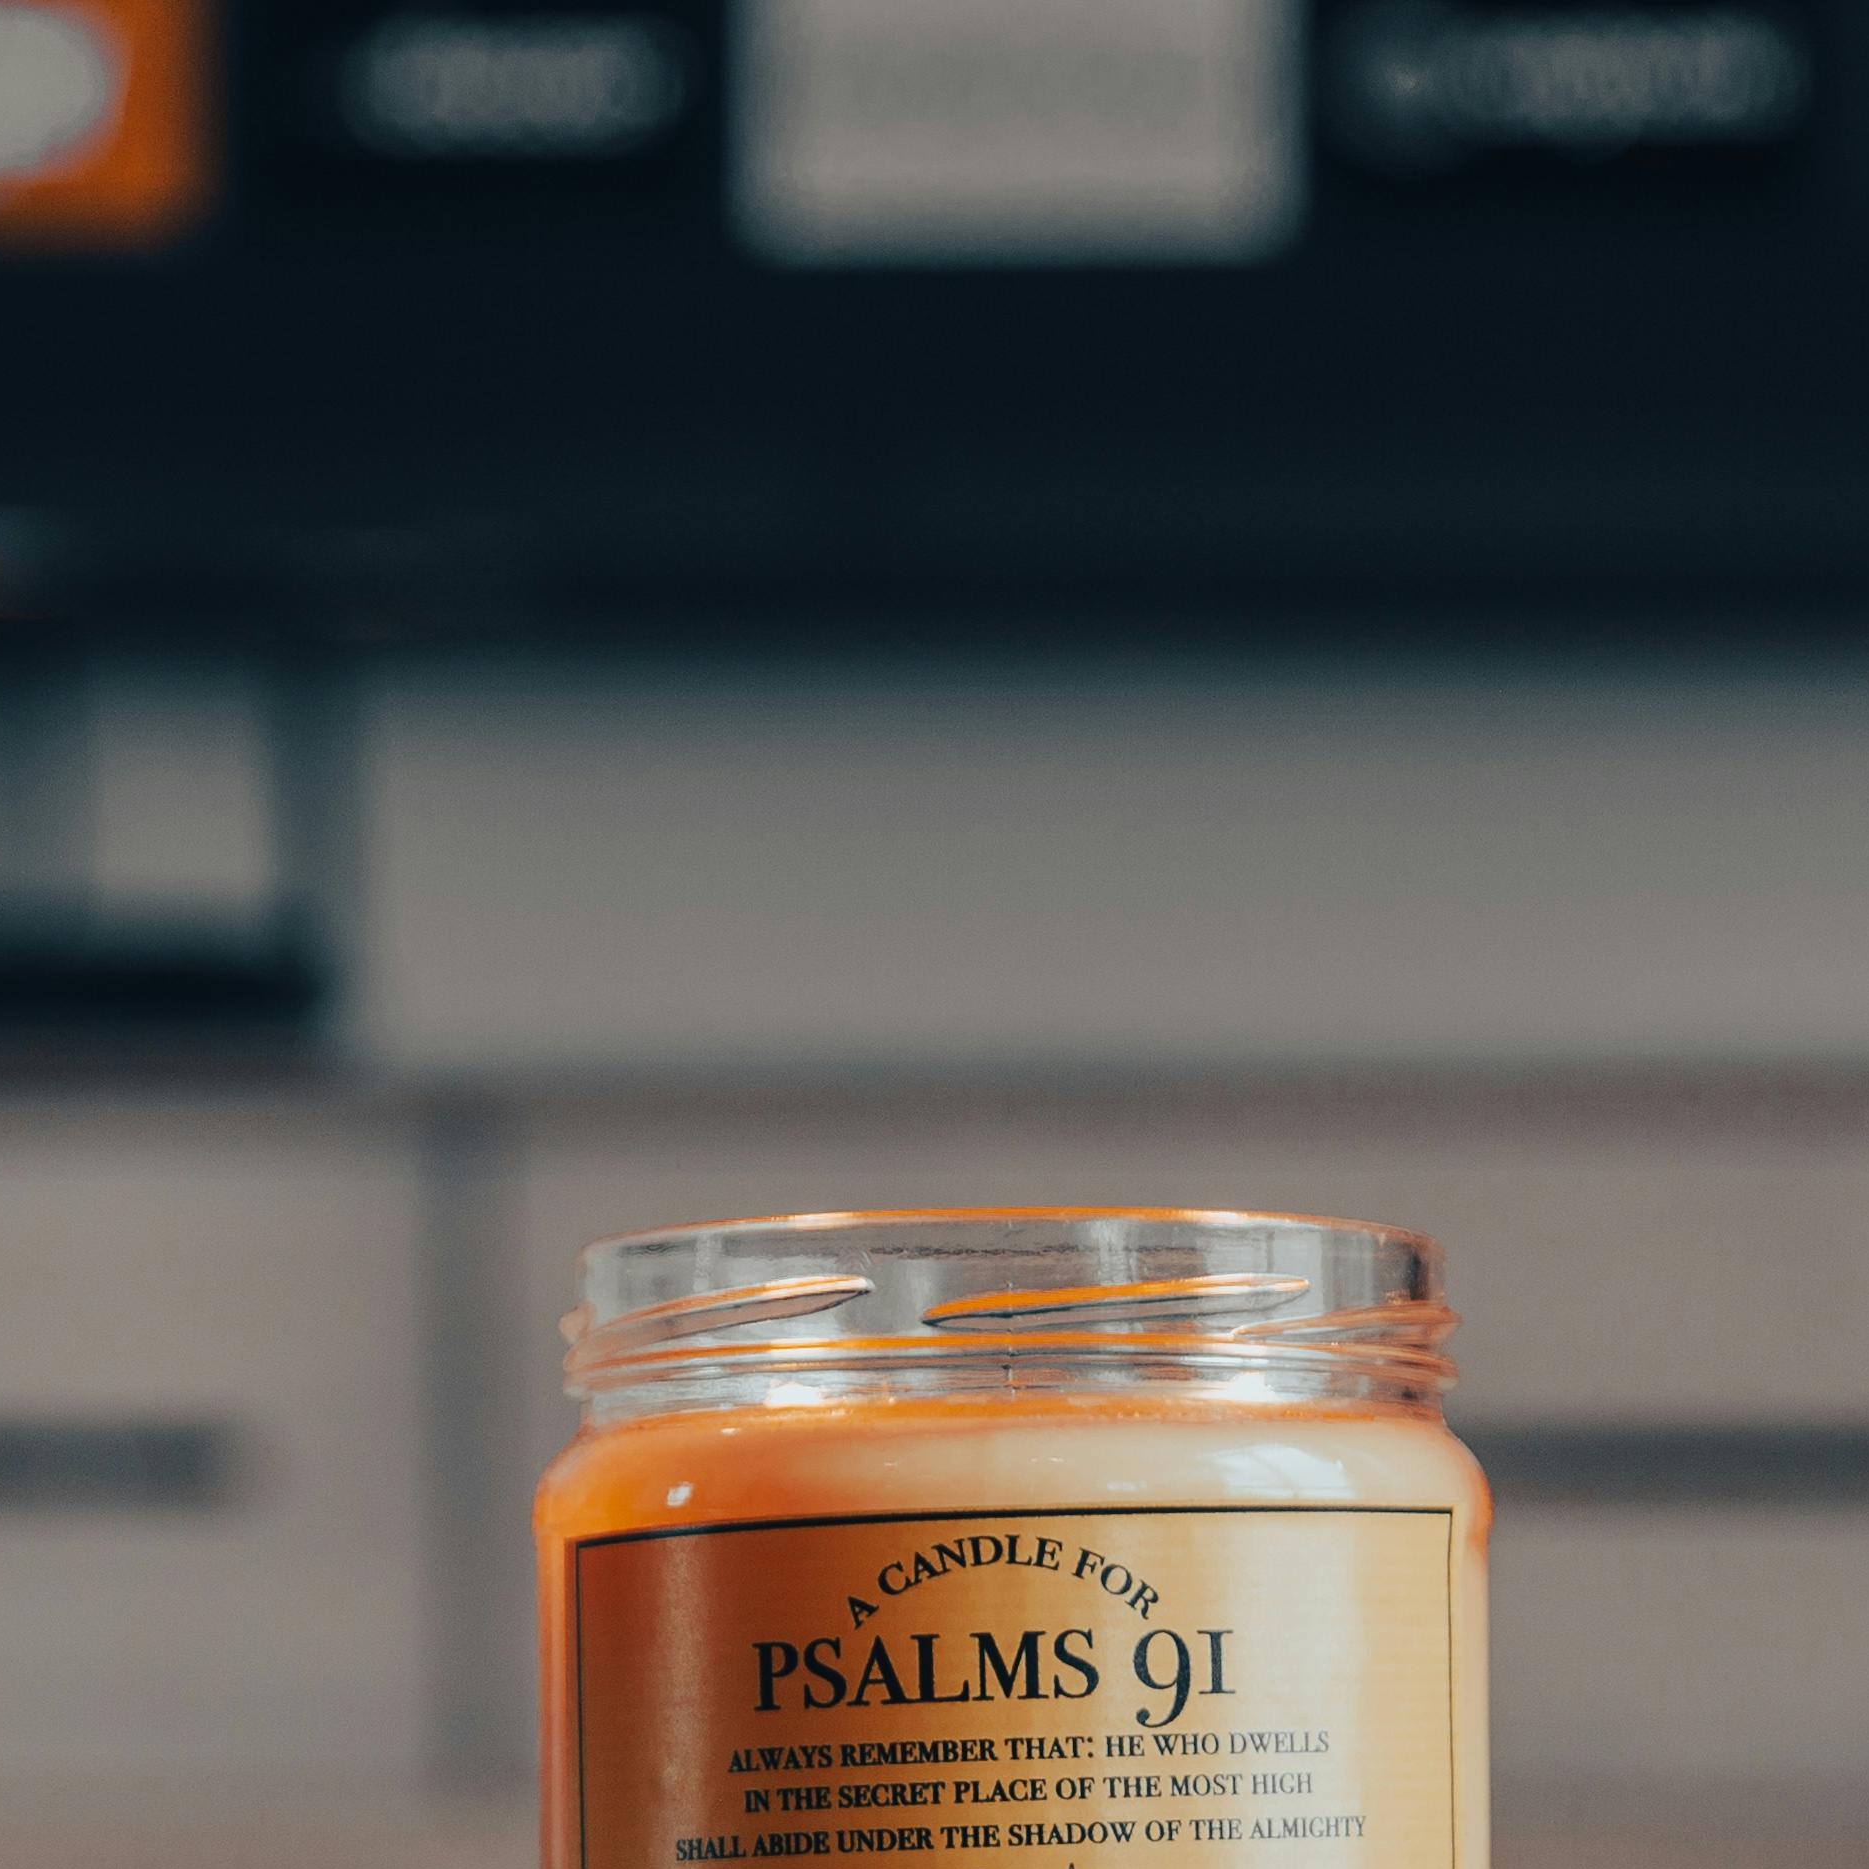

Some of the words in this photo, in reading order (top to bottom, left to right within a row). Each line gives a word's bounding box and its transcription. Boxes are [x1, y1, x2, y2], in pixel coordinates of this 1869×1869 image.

[847, 1594, 879, 1629] A
[877, 1534, 1063, 1596] CANDLE
[1071, 1547, 1160, 1620] FOR
[751, 1627, 1100, 1713] PSALMS
[1132, 1628, 1236, 1729] 91
[728, 1744, 833, 1773] ALWAYS
[839, 1738, 999, 1768] REMEMBER
[1004, 1735, 1094, 1760] THAT:
[1105, 1734, 1146, 1758] HE
[1152, 1732, 1220, 1756] WHO
[1228, 1730, 1330, 1754] DWELLS
[744, 1789, 771, 1813] IN
[777, 1786, 832, 1811] THE
[838, 1782, 946, 1808] SECRET
[953, 1777, 1047, 1803] PLACE
[1055, 1776, 1095, 1800] OF
[1103, 1775, 1162, 1798] THE
[1169, 1773, 1243, 1797] MOST
[1251, 1772, 1313, 1795] HIGH
[676, 1836, 747, 1861] SHALL
[751, 1831, 830, 1857] ABIDE
[836, 1827, 934, 1853] UNDER
[940, 1824, 1000, 1849] THE
[1007, 1820, 1138, 1847] SHADOW
[1145, 1819, 1182, 1842] OF
[1189, 1818, 1243, 1841] THE
[1249, 1815, 1367, 1839] ALMIGHTY
